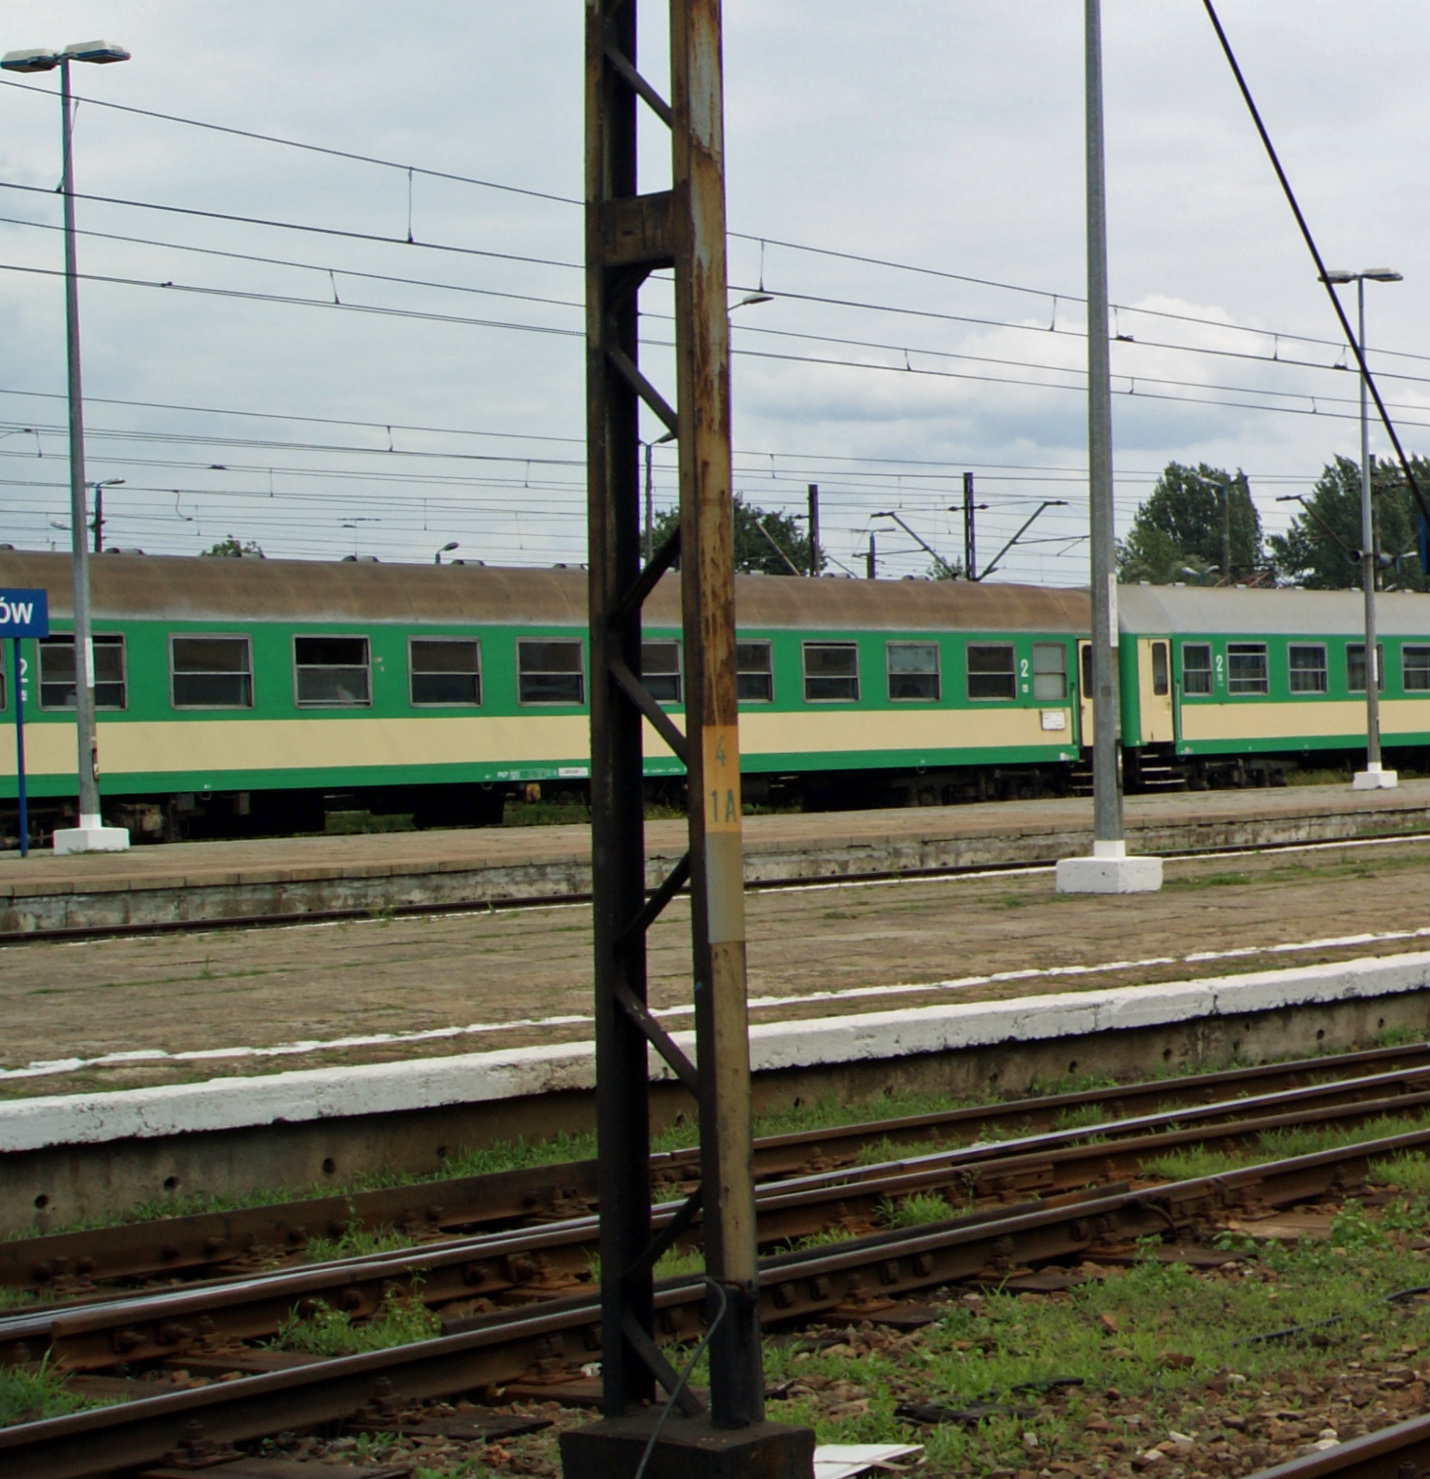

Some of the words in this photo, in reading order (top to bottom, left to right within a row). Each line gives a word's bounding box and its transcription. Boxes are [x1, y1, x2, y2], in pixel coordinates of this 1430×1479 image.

[1020, 658, 1029, 678] 2
[1215, 654, 1224, 672] 2
[715, 733, 726, 767] 4
